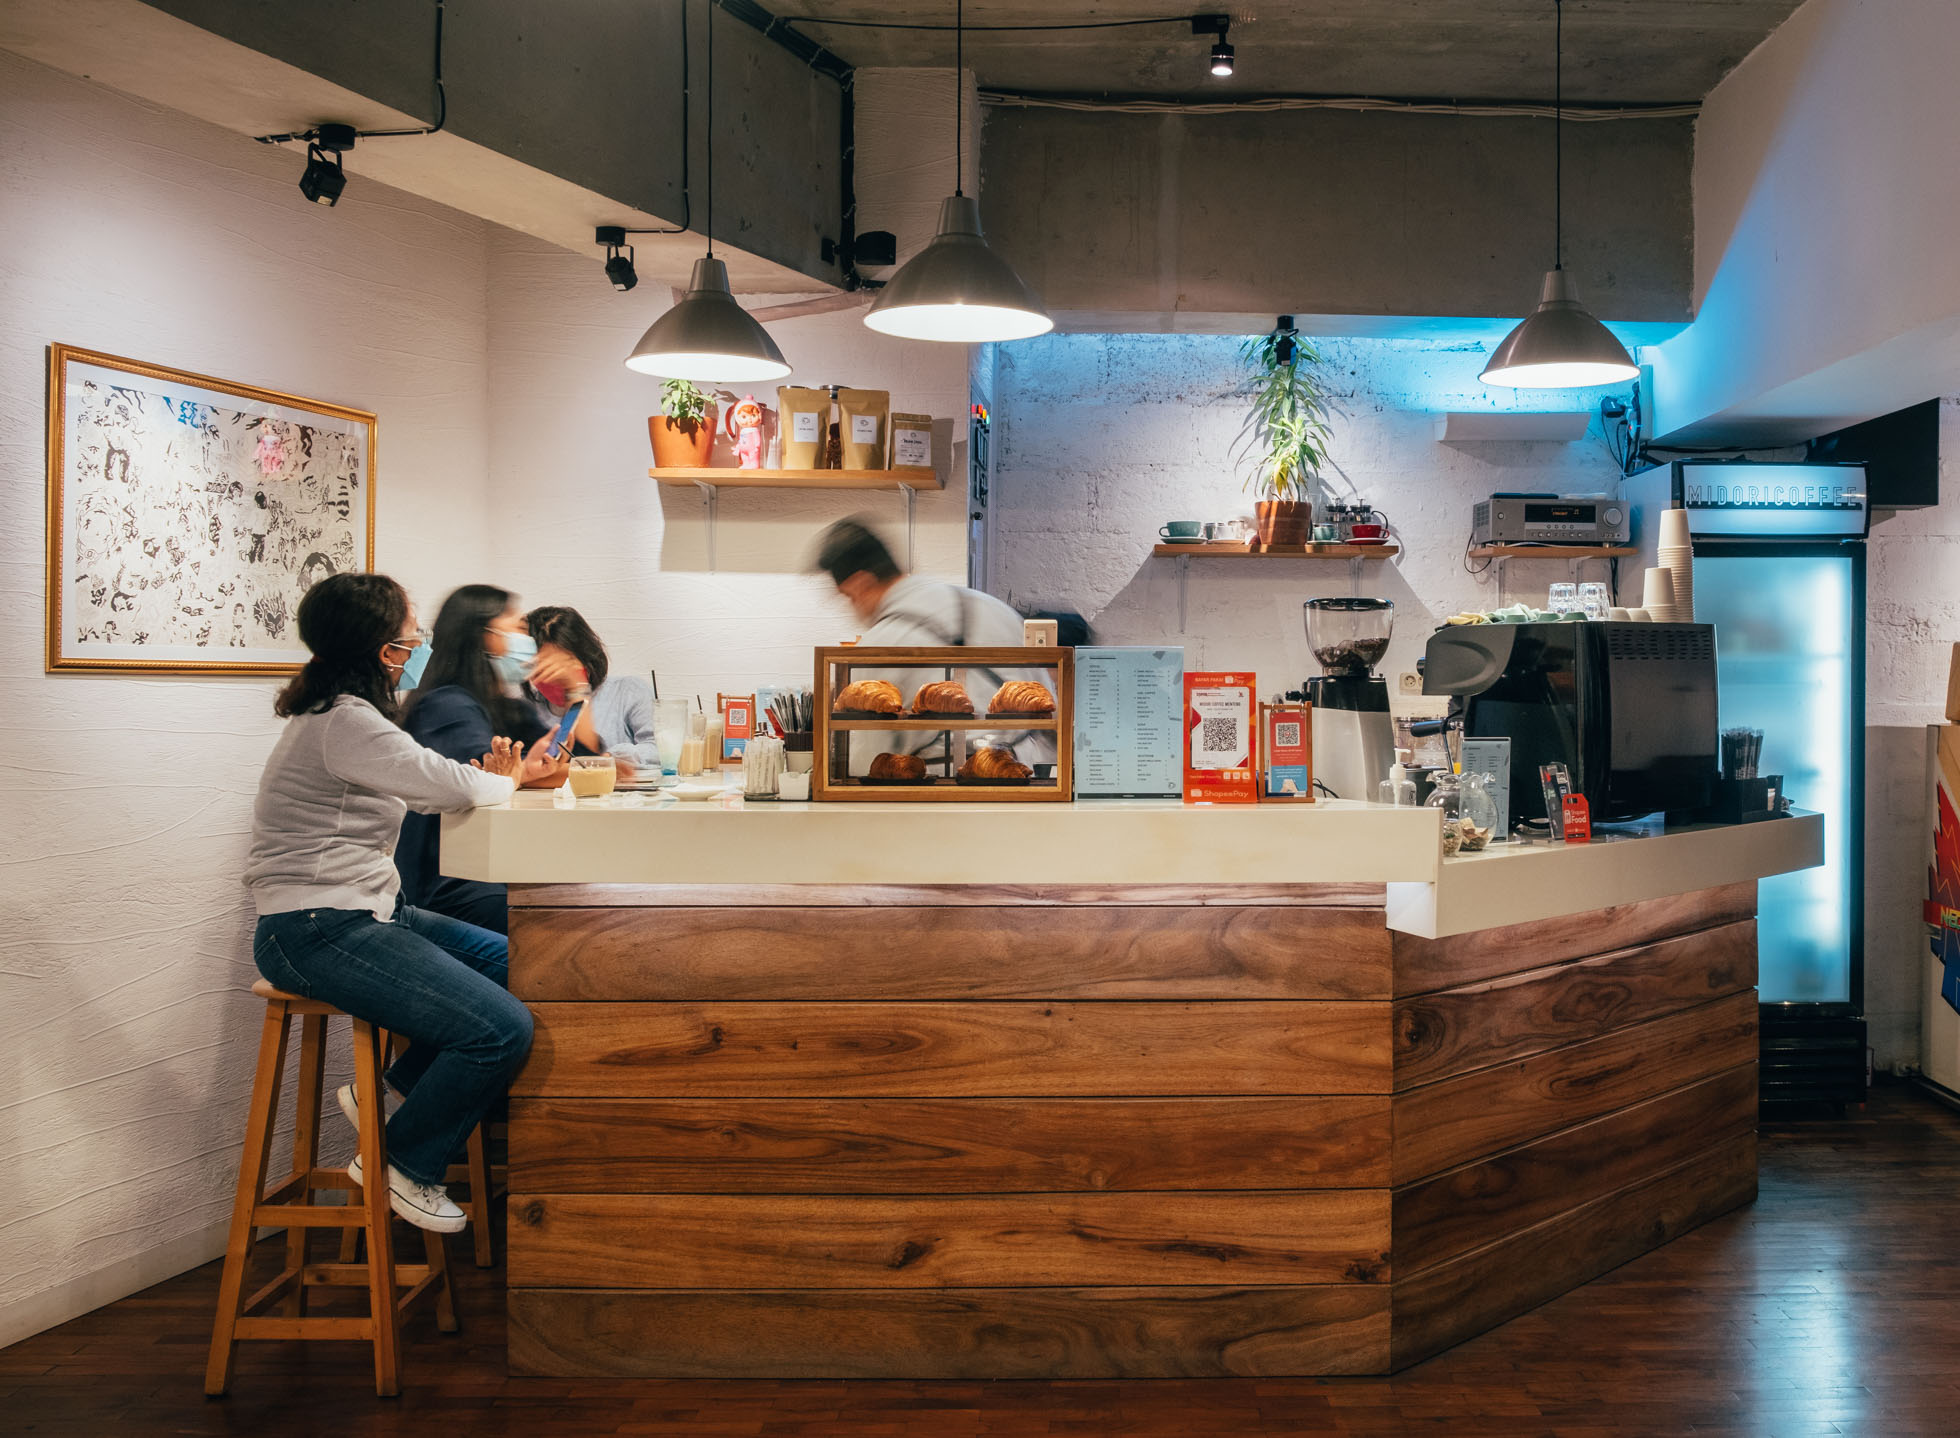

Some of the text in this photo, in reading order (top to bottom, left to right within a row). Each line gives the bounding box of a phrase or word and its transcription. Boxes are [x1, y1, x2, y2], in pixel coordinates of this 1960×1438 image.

[1688, 485, 1857, 506] MIDORICOFFEE
[1204, 790, 1248, 798] ShopeePay
[1571, 815, 1587, 824] Food
